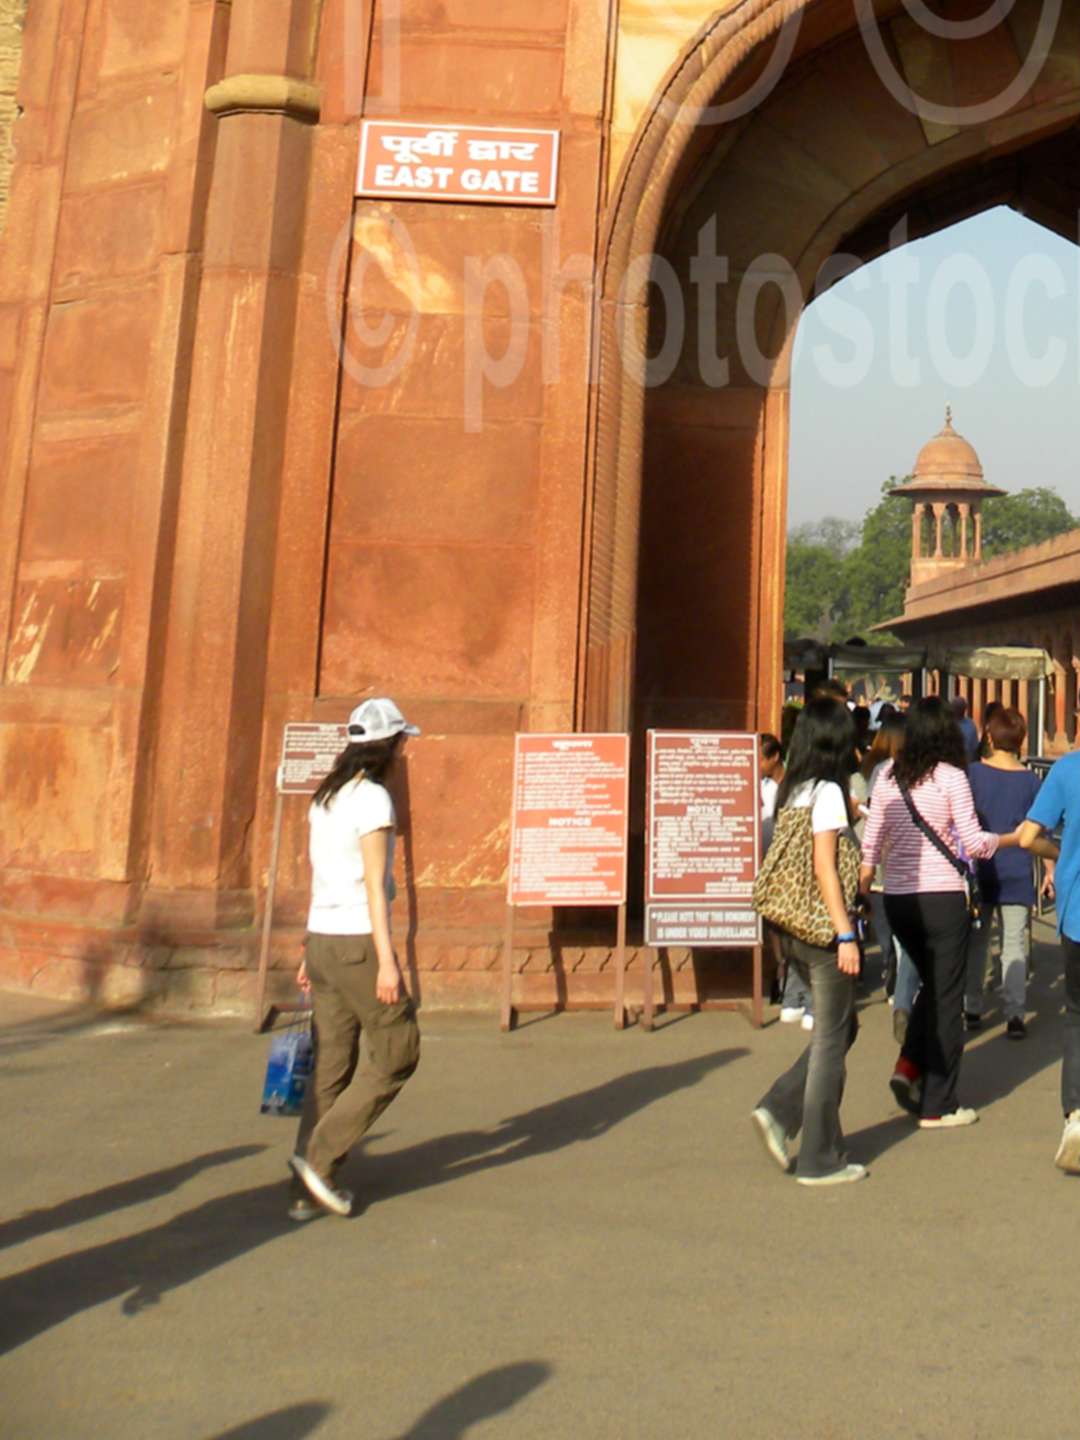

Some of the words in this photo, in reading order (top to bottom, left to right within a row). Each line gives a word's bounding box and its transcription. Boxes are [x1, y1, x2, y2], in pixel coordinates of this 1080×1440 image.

[380, 131, 459, 164] पूर्वी
[467, 139, 540, 161] द्वार
[374, 164, 454, 189] EAST
[460, 168, 539, 193] GATE
